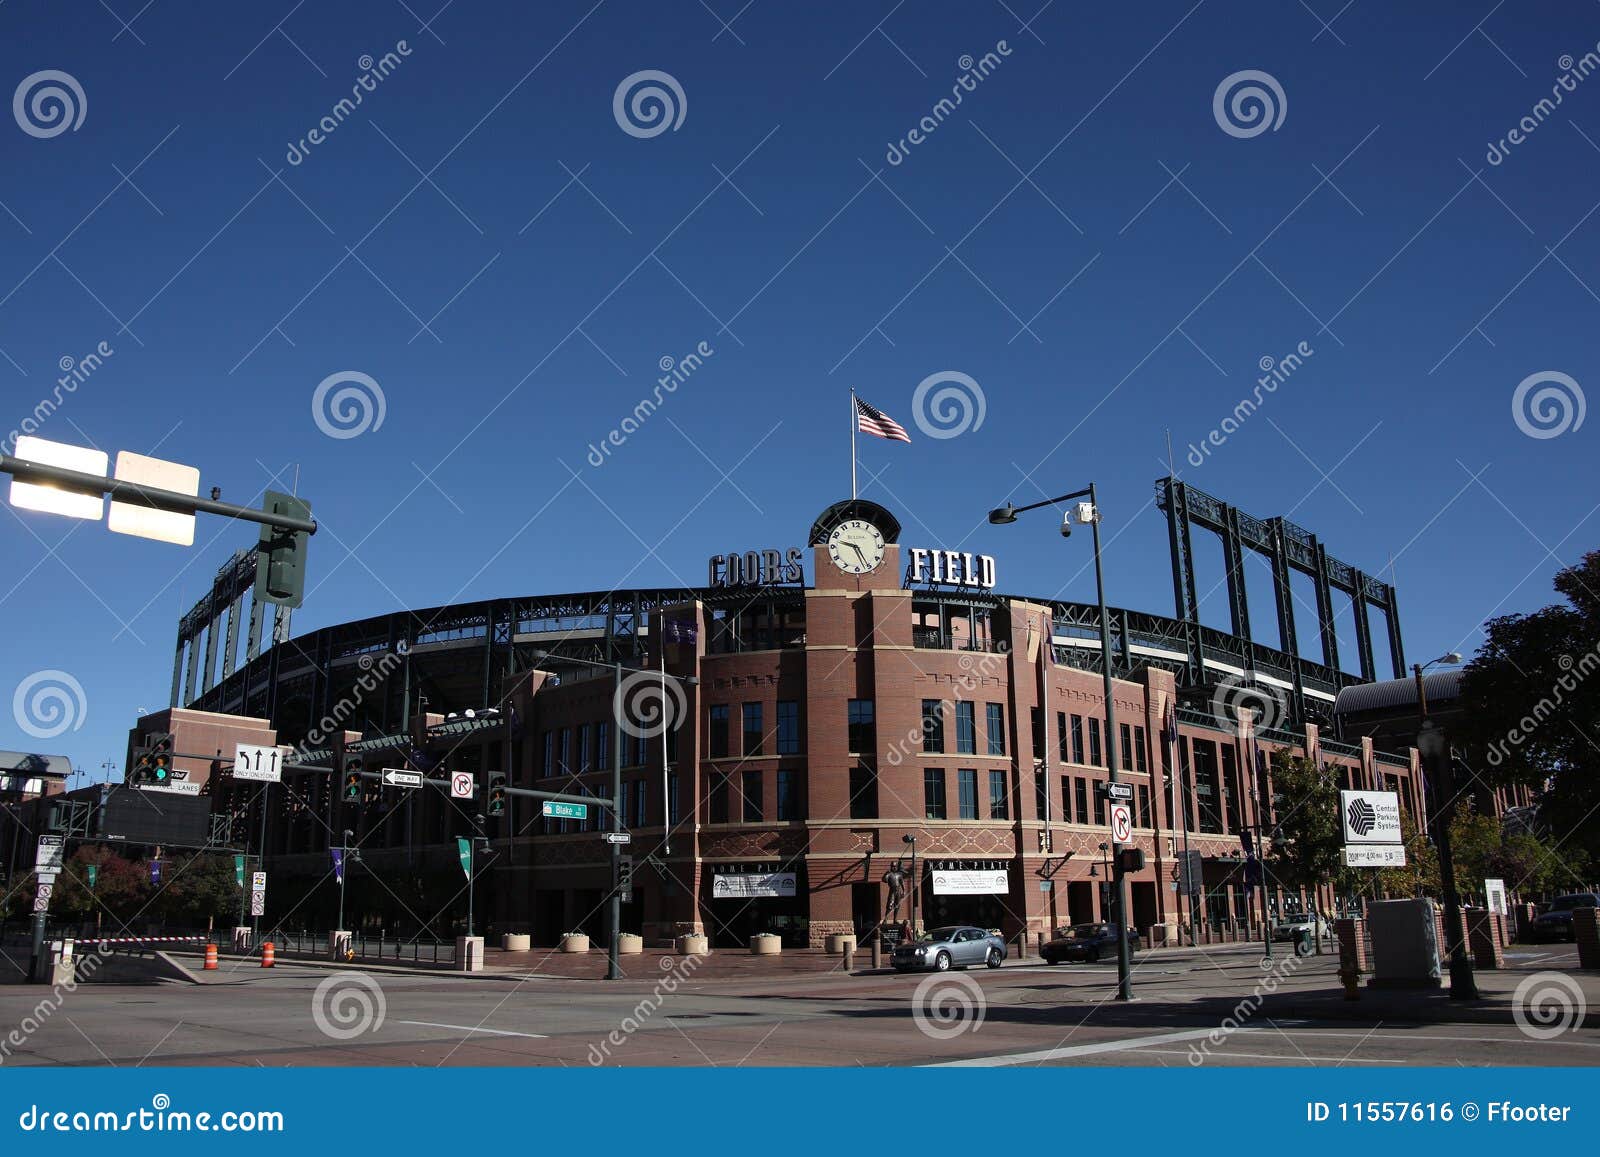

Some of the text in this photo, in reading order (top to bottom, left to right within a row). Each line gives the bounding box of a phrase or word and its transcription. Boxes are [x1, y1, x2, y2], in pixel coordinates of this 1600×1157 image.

[709, 547, 997, 588] COORS FIELD
[178, 784, 198, 792] LANES
[555, 804, 573, 816] Blake
[1375, 804, 1397, 812] Central
[1376, 813, 1399, 822] Parking
[1377, 822, 1400, 831] System
[929, 861, 1010, 871] HOME PLATE
